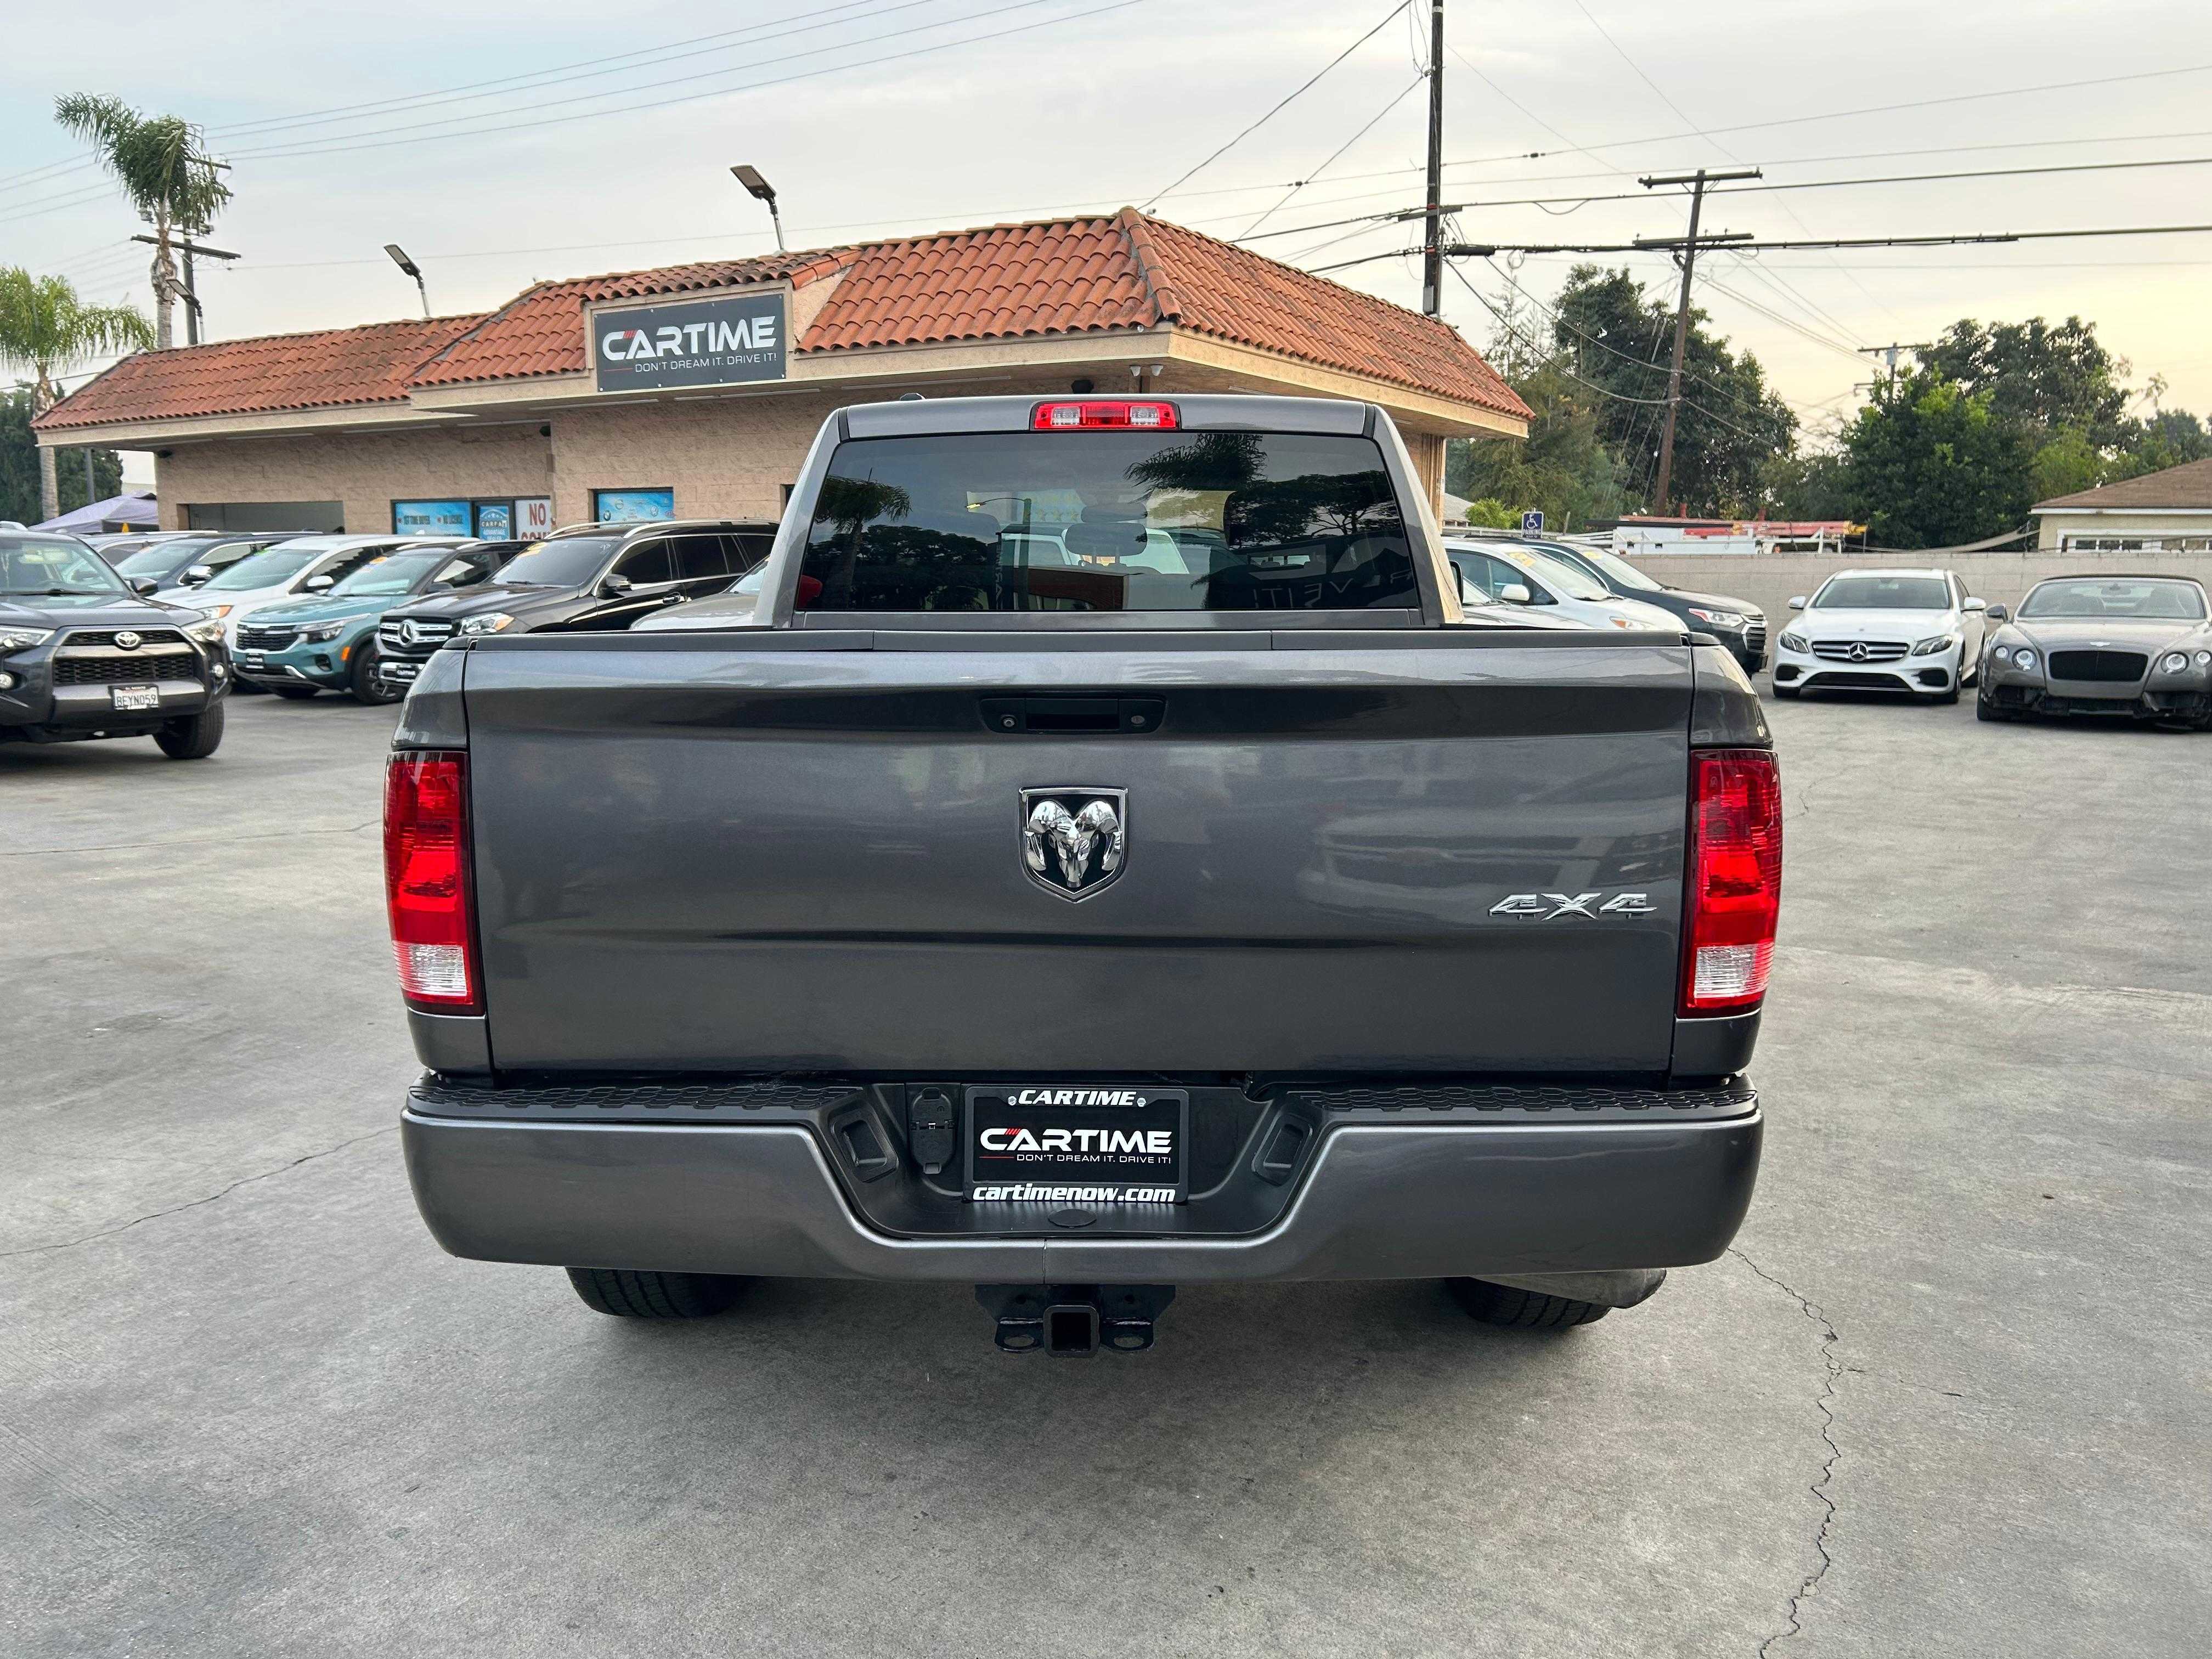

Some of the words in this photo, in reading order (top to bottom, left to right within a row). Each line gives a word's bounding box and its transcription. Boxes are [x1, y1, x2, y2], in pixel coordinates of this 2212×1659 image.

[602, 316, 776, 360] CARTIME
[635, 362, 667, 373] DON'T
[670, 358, 709, 370] DREAM
[713, 357, 724, 366] IT.
[727, 353, 760, 365] DRIVE
[764, 353, 777, 362] IT!
[529, 503, 546, 526] NO
[1487, 893, 1658, 921] 4X4
[1018, 1090, 1137, 1106] CARTIME
[980, 1128, 1172, 1154] CARTIME
[1057, 1154, 1099, 1163] DREAM
[1119, 1155, 1154, 1164] DRIVE
[972, 1183, 1176, 1203] cartimenow.com
